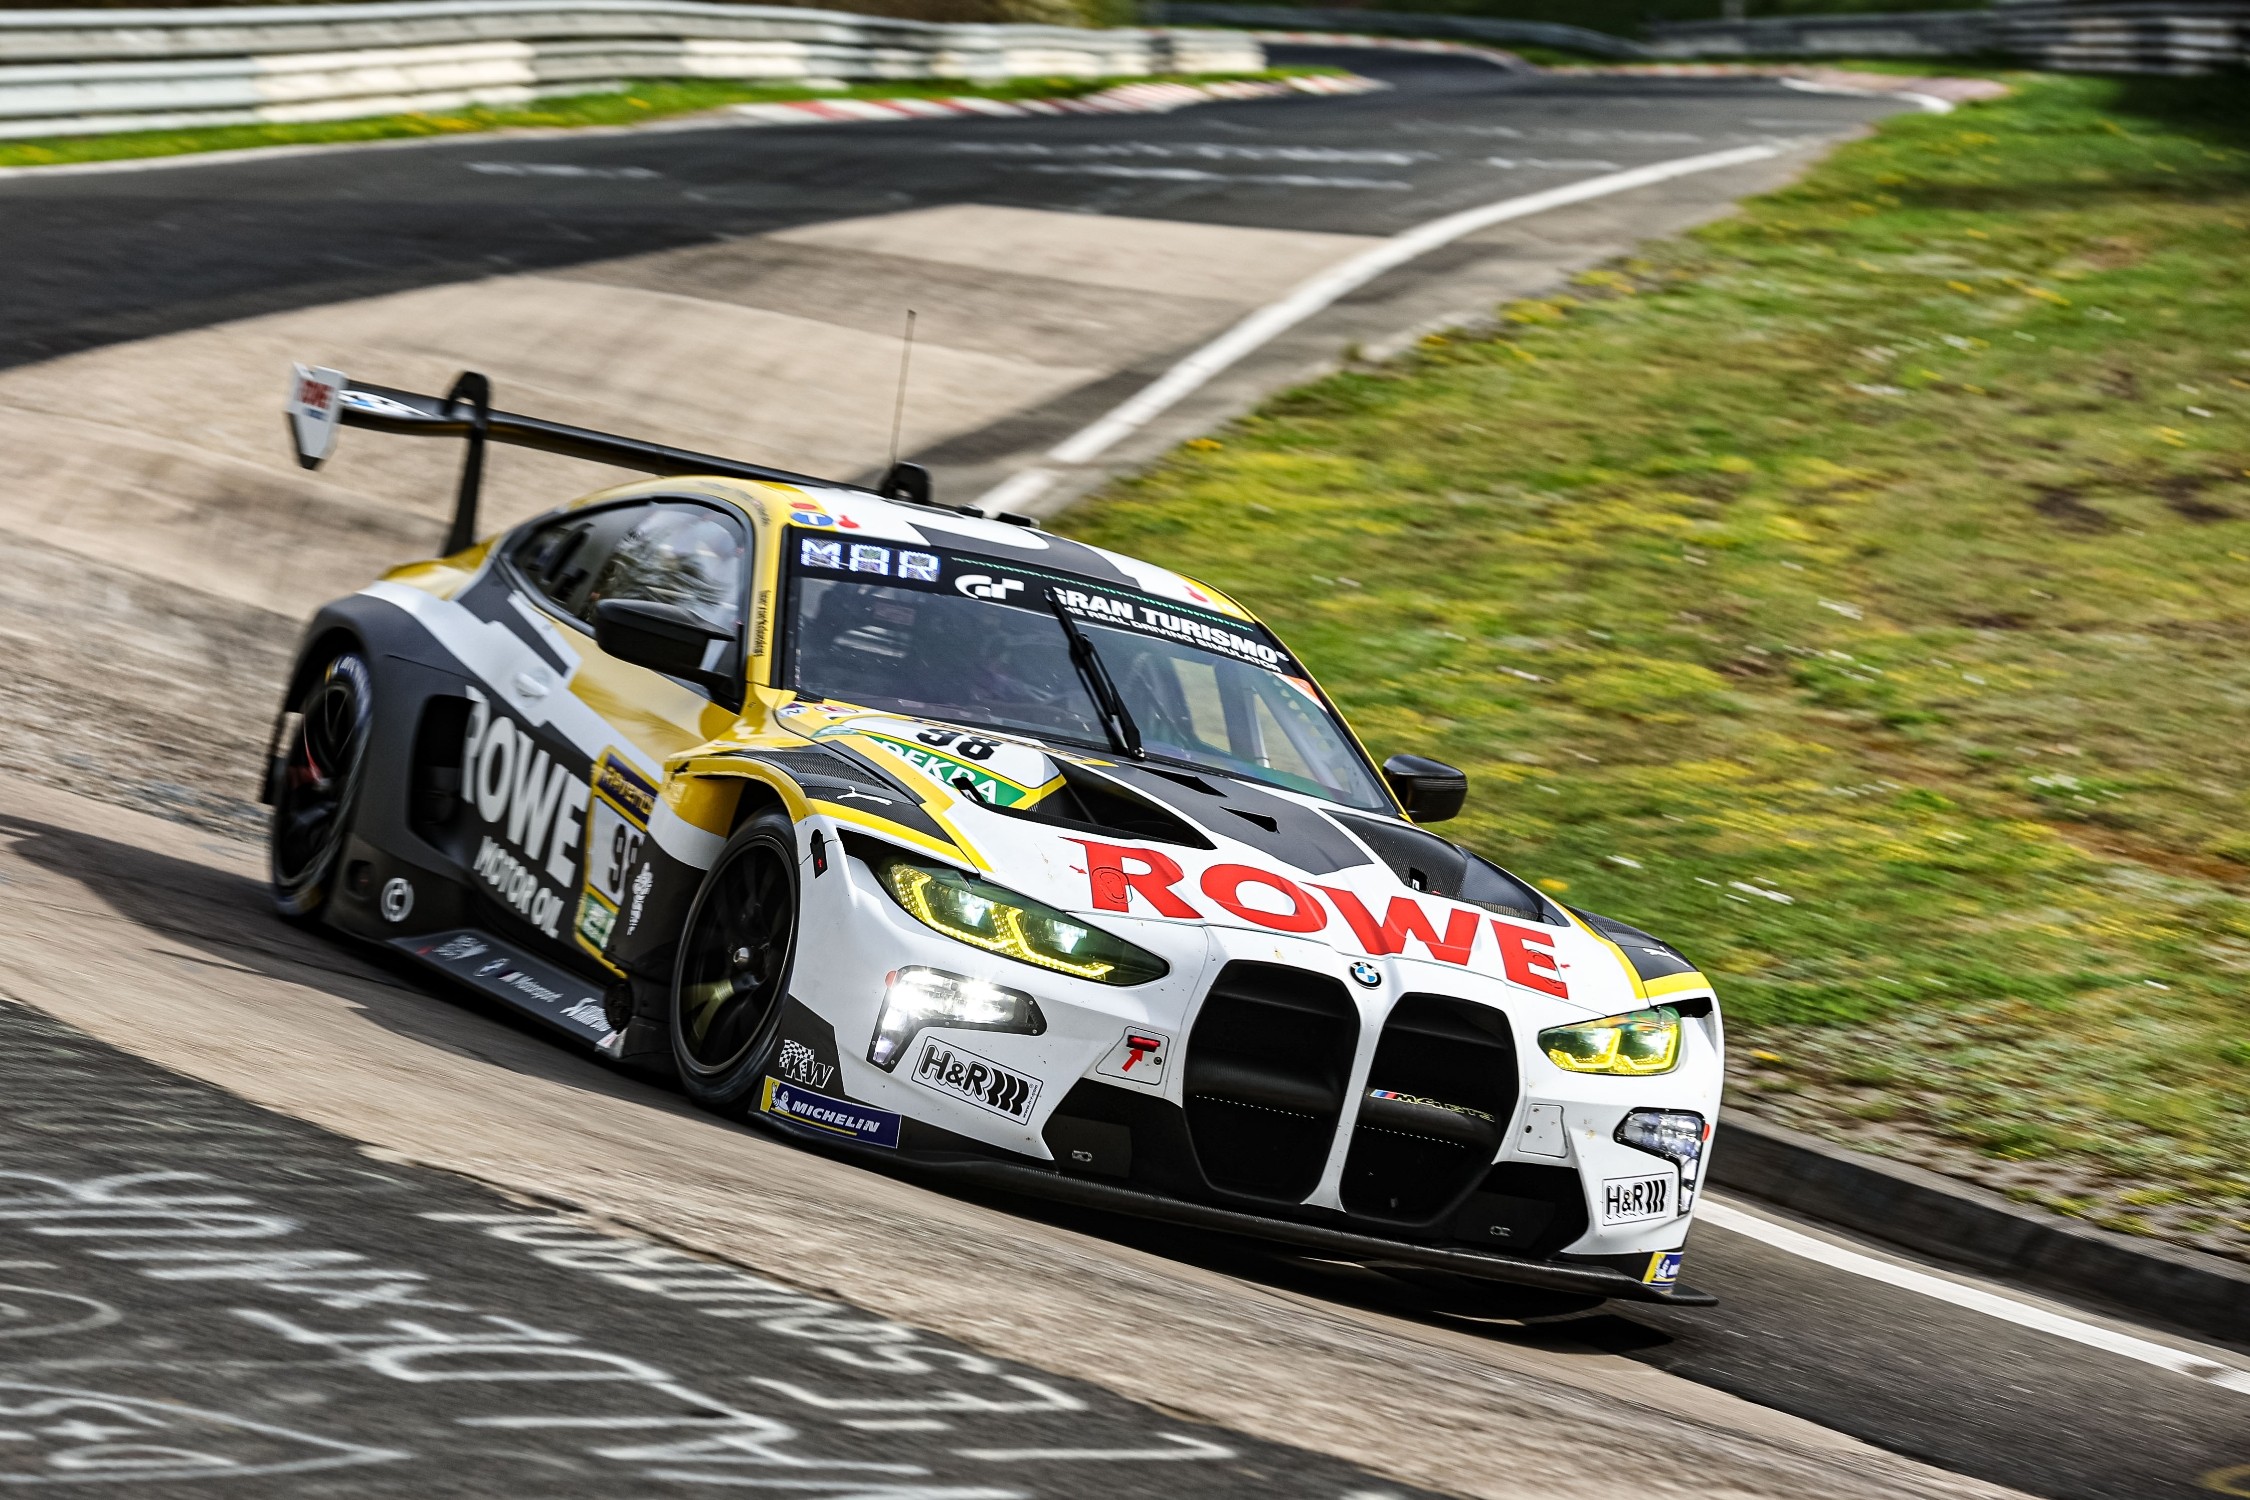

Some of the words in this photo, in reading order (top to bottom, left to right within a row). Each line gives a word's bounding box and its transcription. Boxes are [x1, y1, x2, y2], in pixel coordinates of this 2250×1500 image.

[800, 538, 941, 583] MAR
[1053, 586, 1134, 620] GRAN
[1088, 609, 1129, 627] REAL
[1129, 619, 1195, 644] DRIVING
[1196, 636, 1284, 674] SIMULATOR
[461, 684, 592, 888] ROWE
[881, 740, 997, 804] DEKRA
[473, 835, 539, 914] MOTOR
[530, 887, 565, 939] OIL
[1057, 836, 1570, 1000] ROWE
[785, 1054, 834, 1088] KW
[920, 1045, 992, 1101] H&R
[791, 1100, 880, 1133] MICHELIN
[1606, 1184, 1643, 1217] H&R
